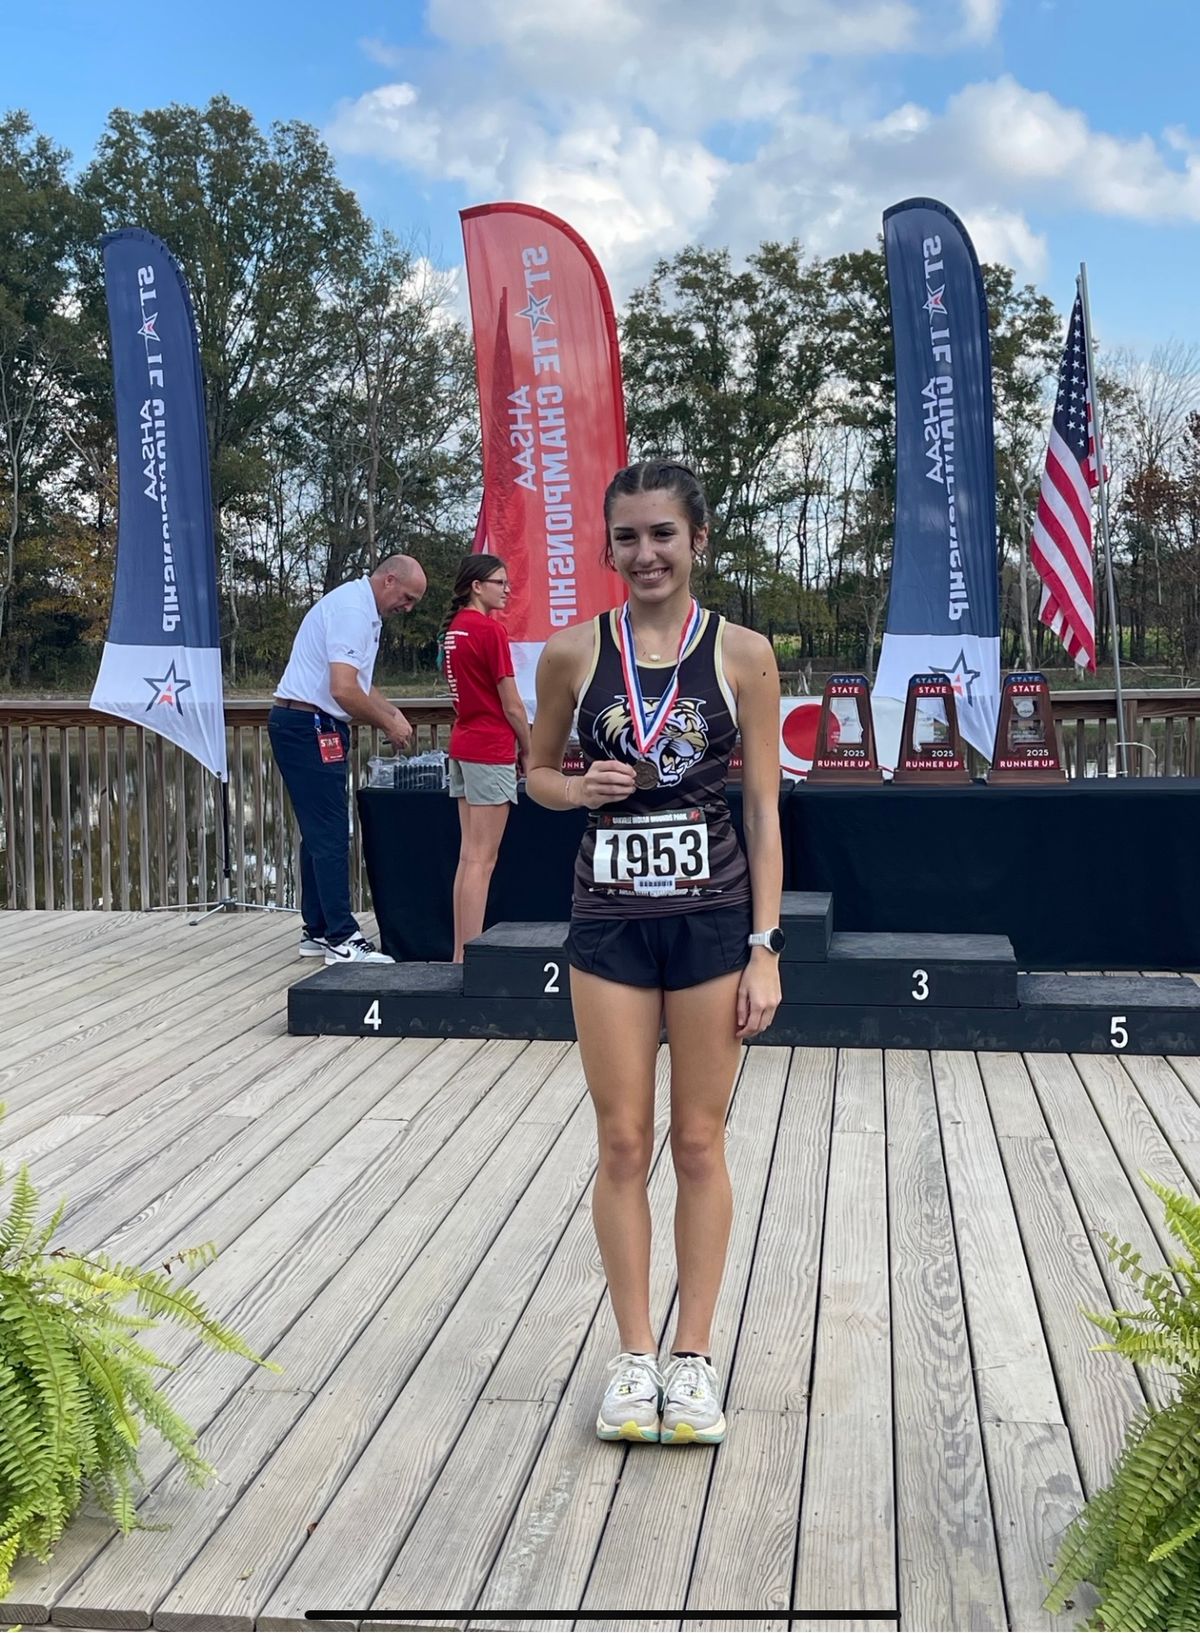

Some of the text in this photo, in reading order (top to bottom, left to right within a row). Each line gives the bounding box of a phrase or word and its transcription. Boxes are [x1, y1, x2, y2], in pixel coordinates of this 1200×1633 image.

[831, 686, 860, 694] STATE
[918, 686, 947, 694] STATE
[1012, 685, 1041, 693] STATE
[843, 749, 865, 757] 2025
[931, 750, 954, 758] 2025
[1026, 749, 1049, 757] 2025
[817, 760, 856, 768] RUNNER
[905, 760, 959, 768] RUNNER UP
[1000, 759, 1055, 768] RUNNER UP
[605, 829, 704, 880] 1953
[543, 962, 560, 993] 2
[911, 968, 930, 1001] 3
[363, 1000, 382, 1031] 4
[1110, 1016, 1129, 1049] 5
